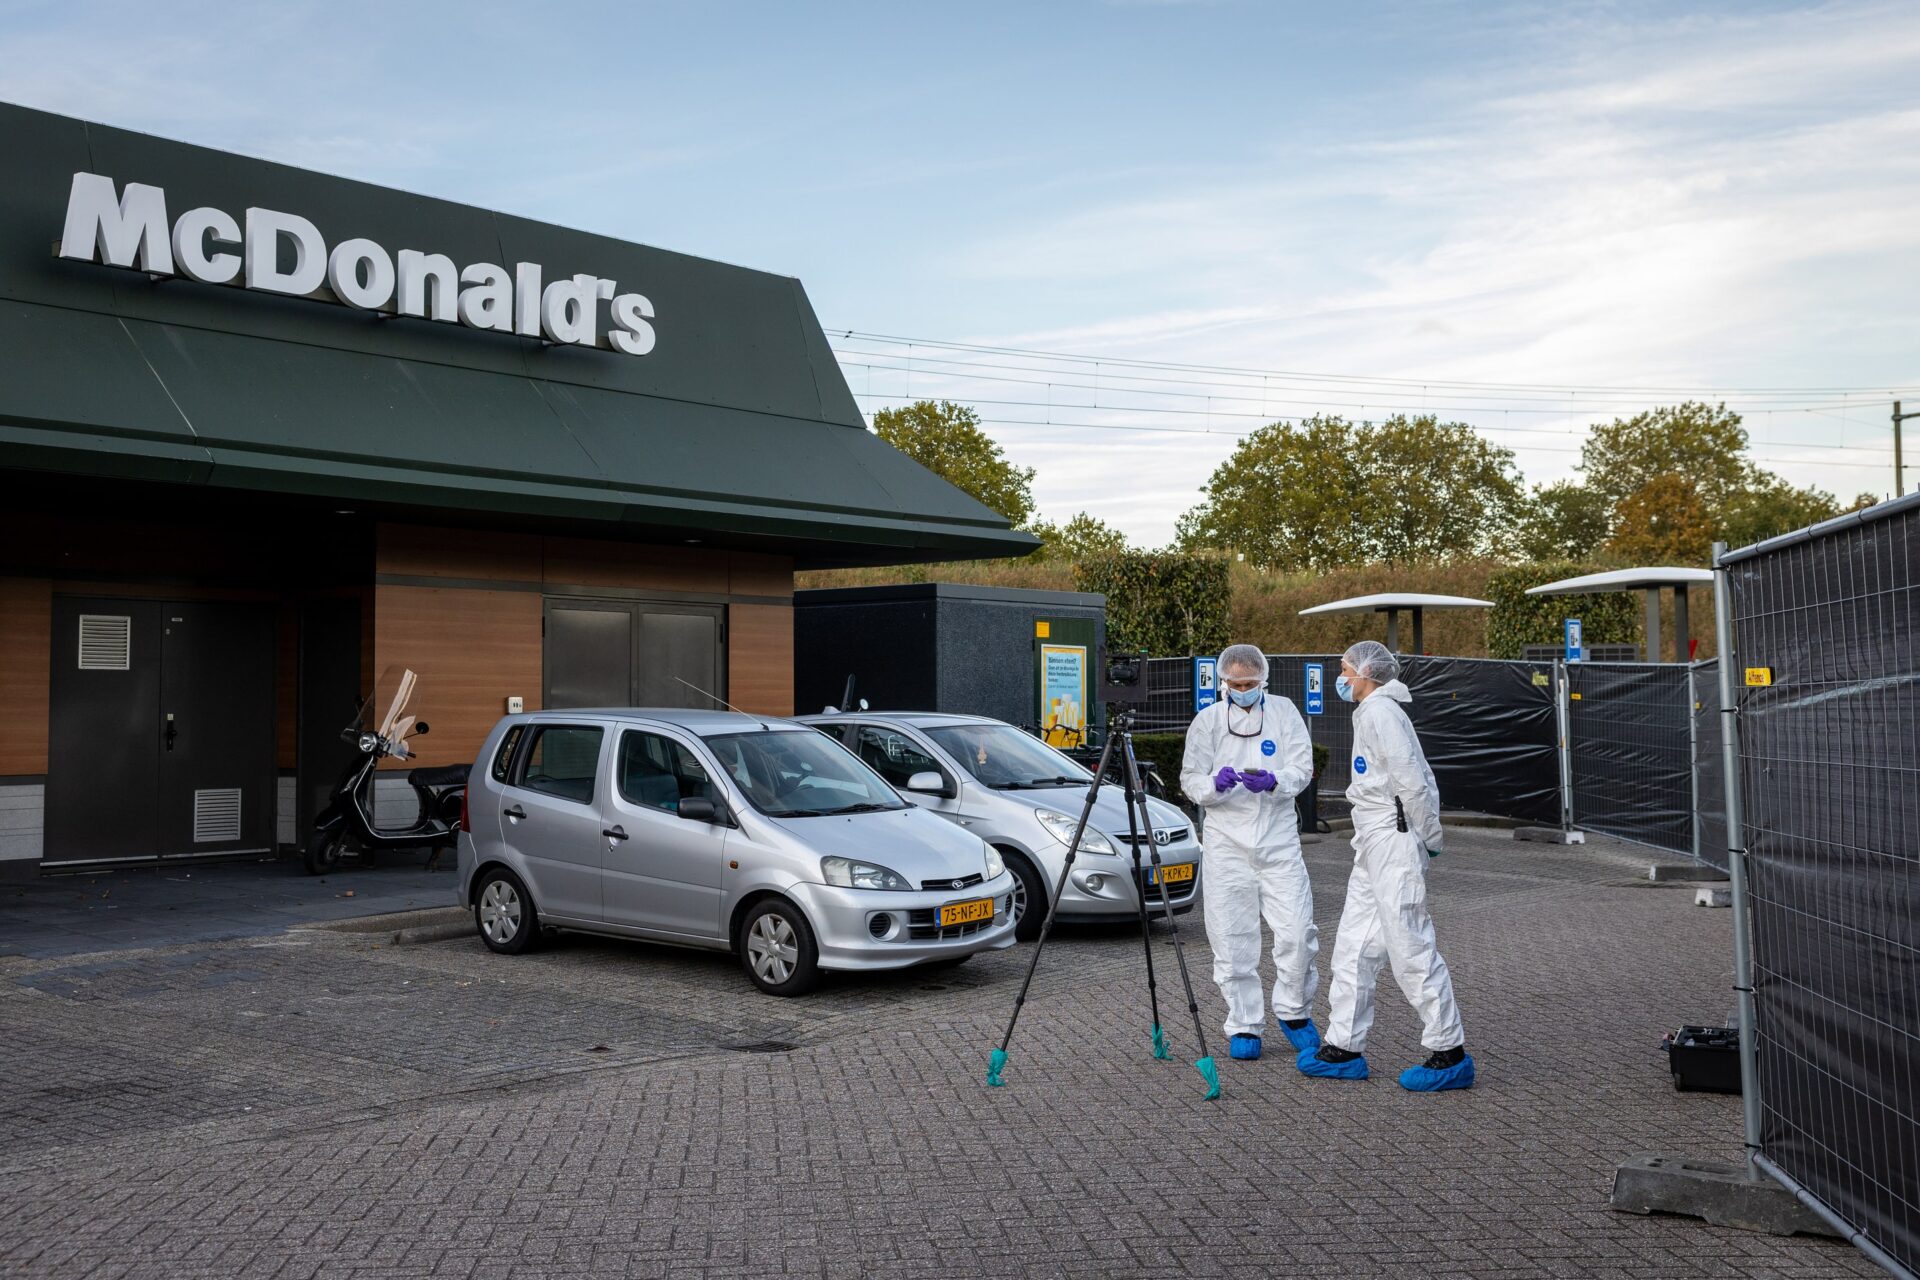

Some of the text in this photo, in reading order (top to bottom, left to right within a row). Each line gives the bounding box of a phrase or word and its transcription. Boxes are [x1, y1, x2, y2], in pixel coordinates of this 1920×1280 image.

[59, 171, 656, 356] McDonald's
[1160, 866, 1189, 880] 1-KPK-2
[944, 902, 989, 922] 75-NF-JX
